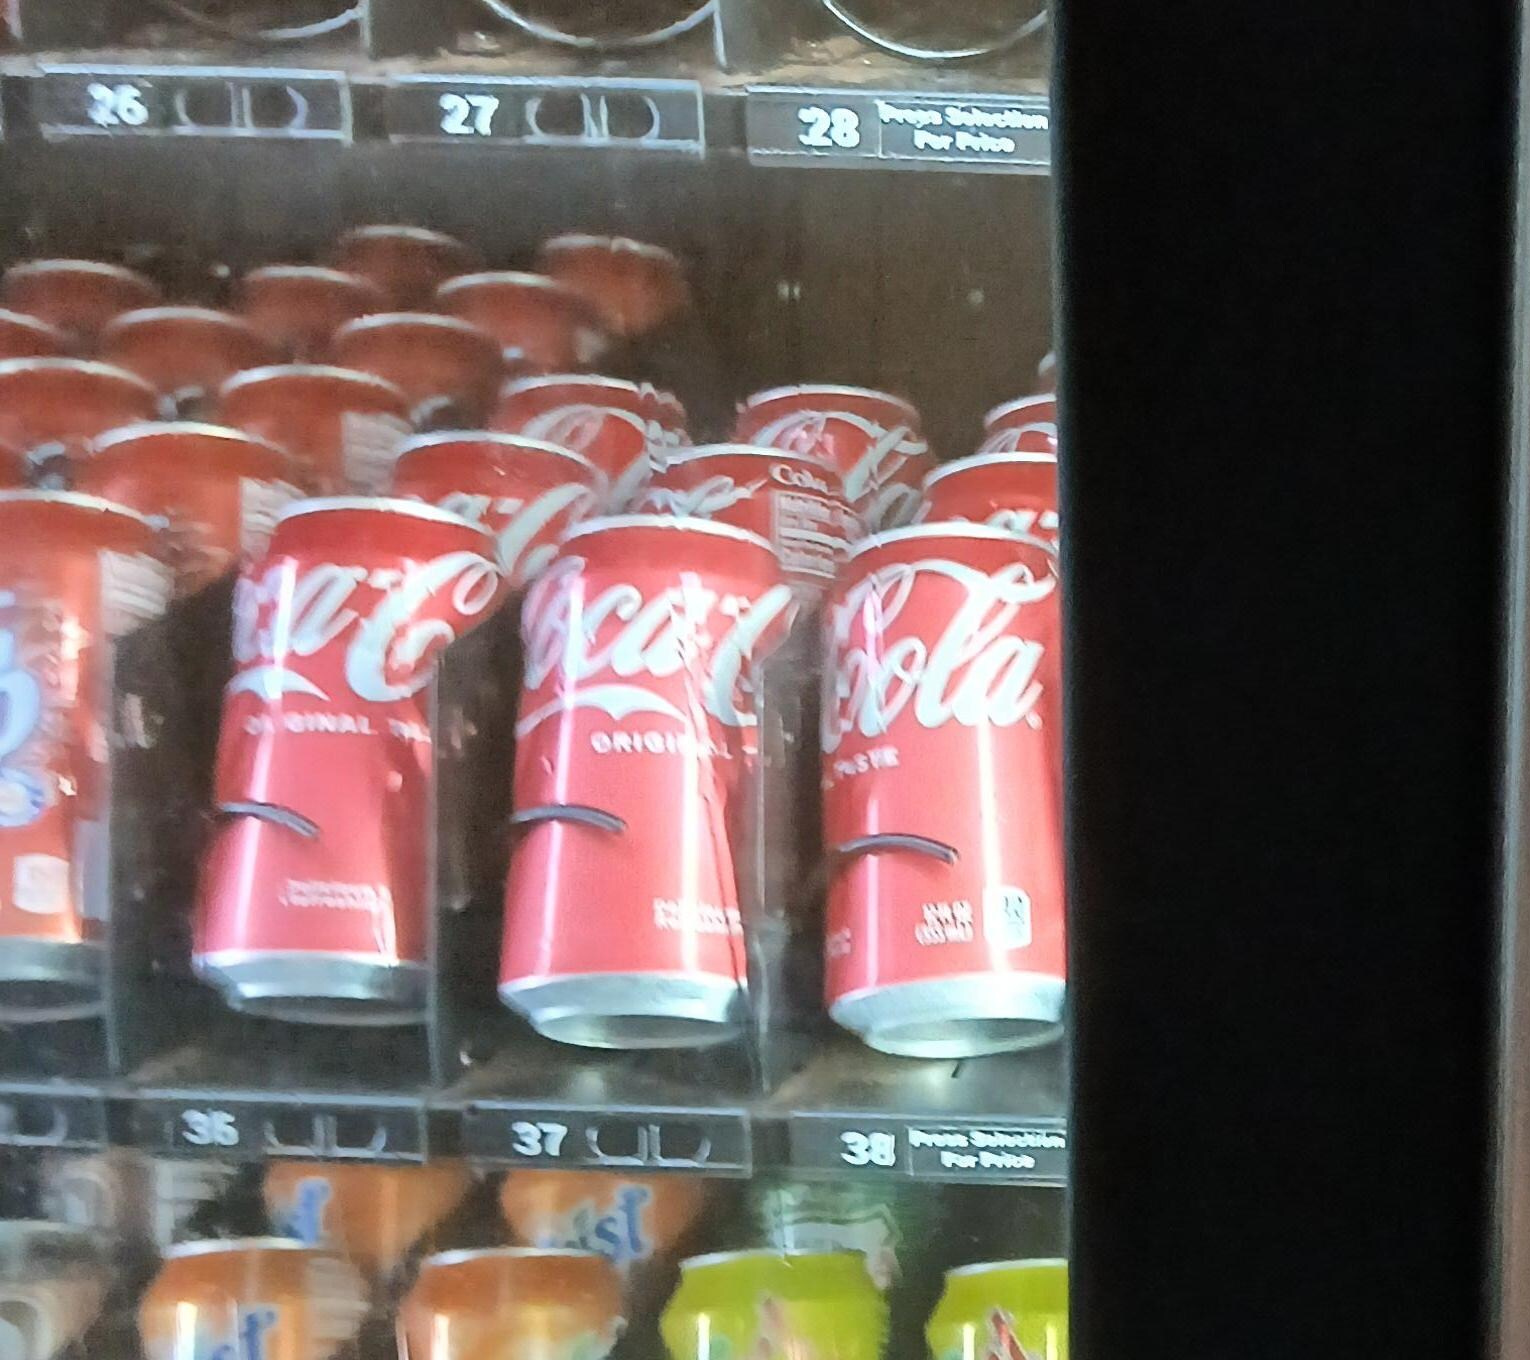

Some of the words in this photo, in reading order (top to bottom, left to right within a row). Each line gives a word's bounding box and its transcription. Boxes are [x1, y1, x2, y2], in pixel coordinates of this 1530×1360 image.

[439, 93, 499, 136] 27
[798, 106, 860, 148] 28
[512, 1121, 568, 1157] 37
[840, 1131, 895, 1167] 38
